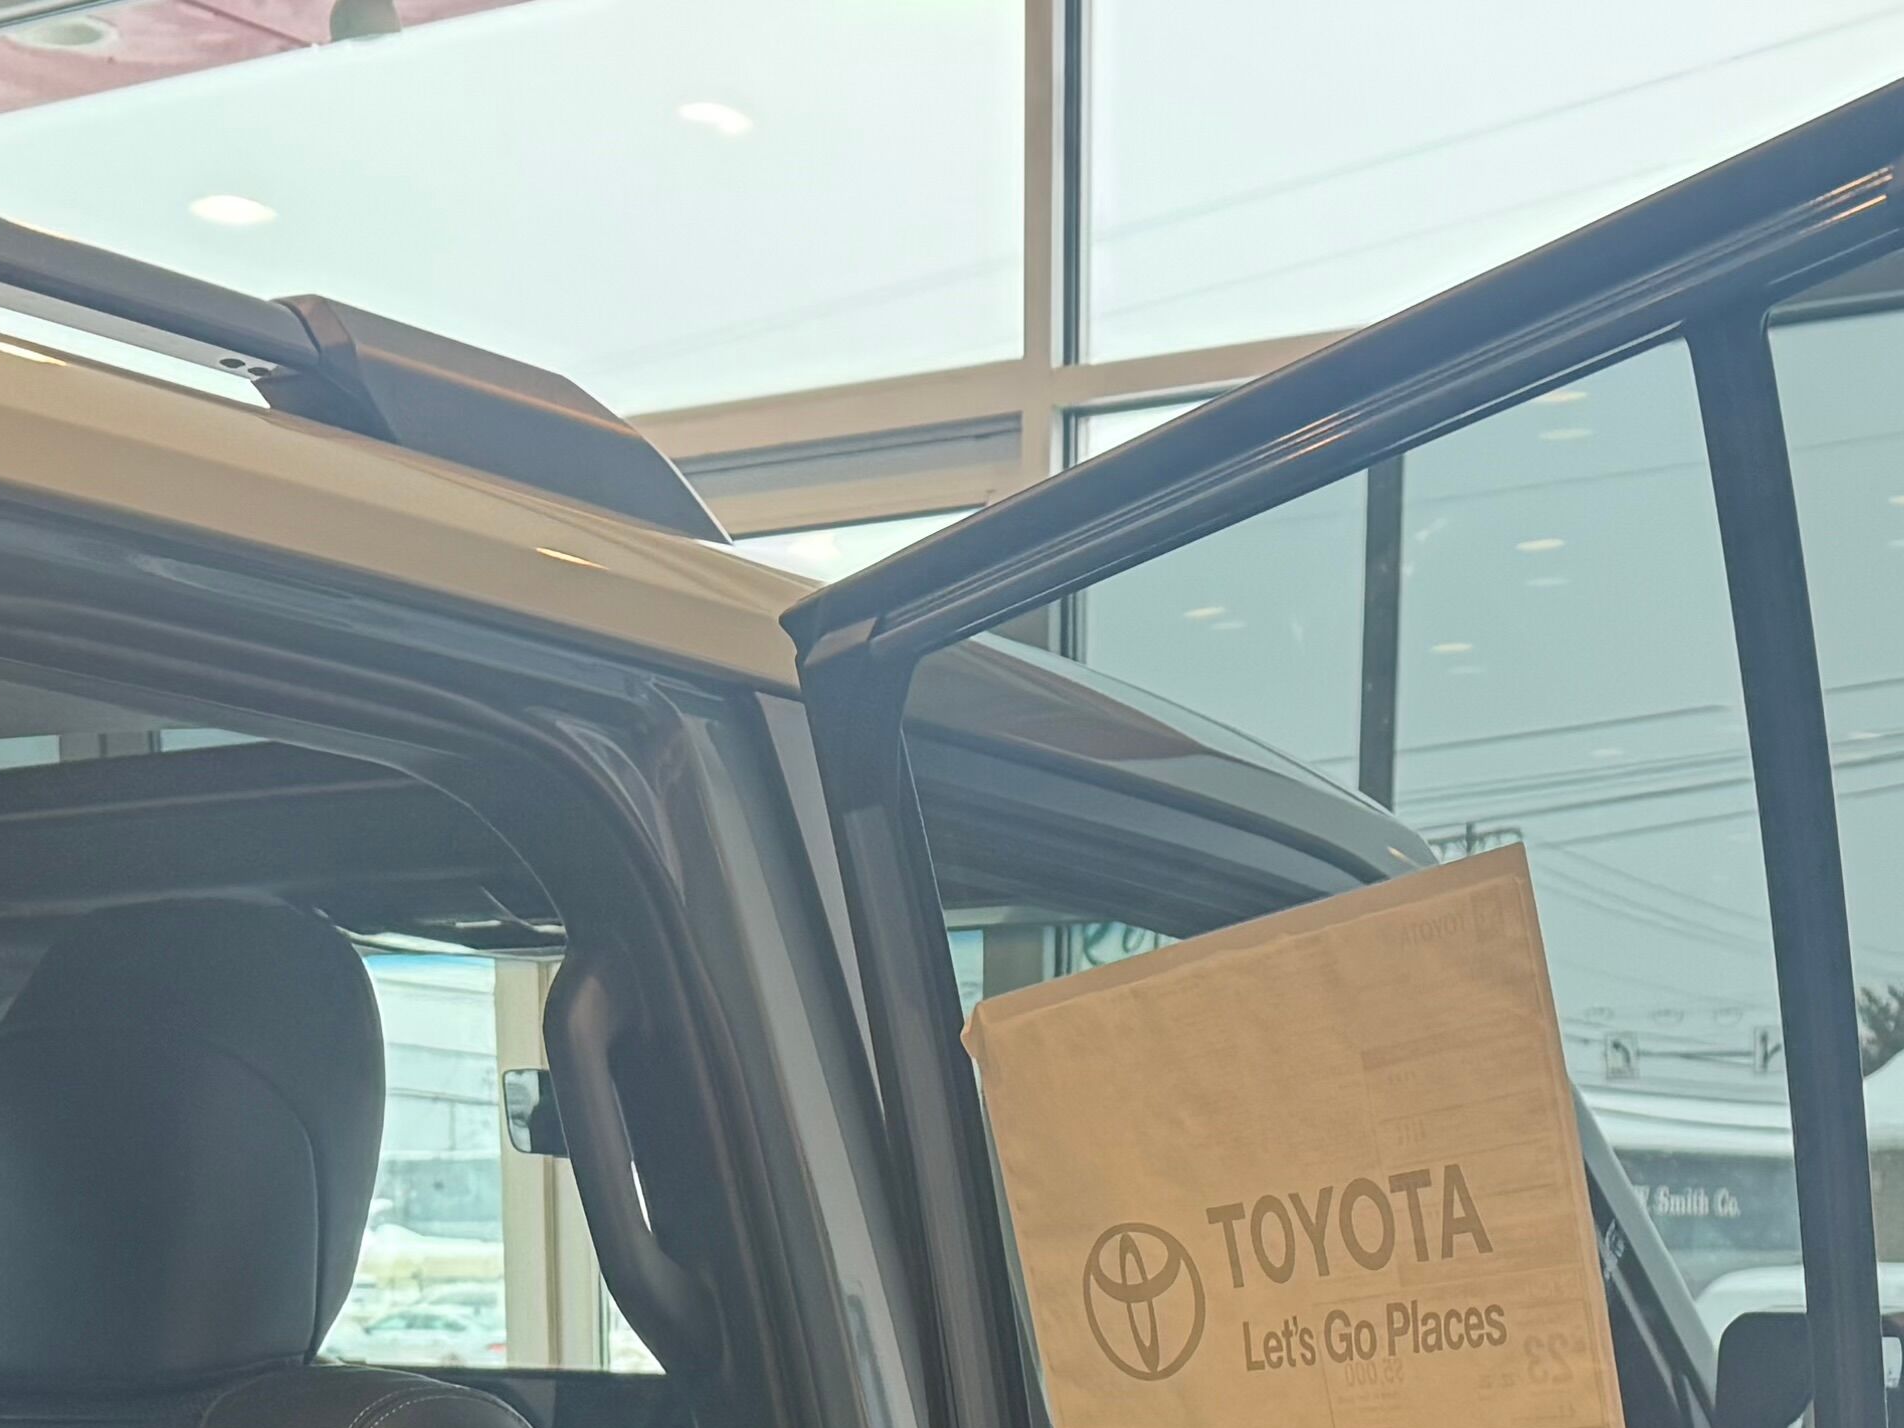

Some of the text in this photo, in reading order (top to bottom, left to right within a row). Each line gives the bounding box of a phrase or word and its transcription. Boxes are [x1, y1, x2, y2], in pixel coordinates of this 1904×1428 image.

[1205, 1164, 1494, 1288] TOYOTA
[1654, 1184, 1709, 1216] Smith
[1242, 1301, 1508, 1372] Let's Go Places
